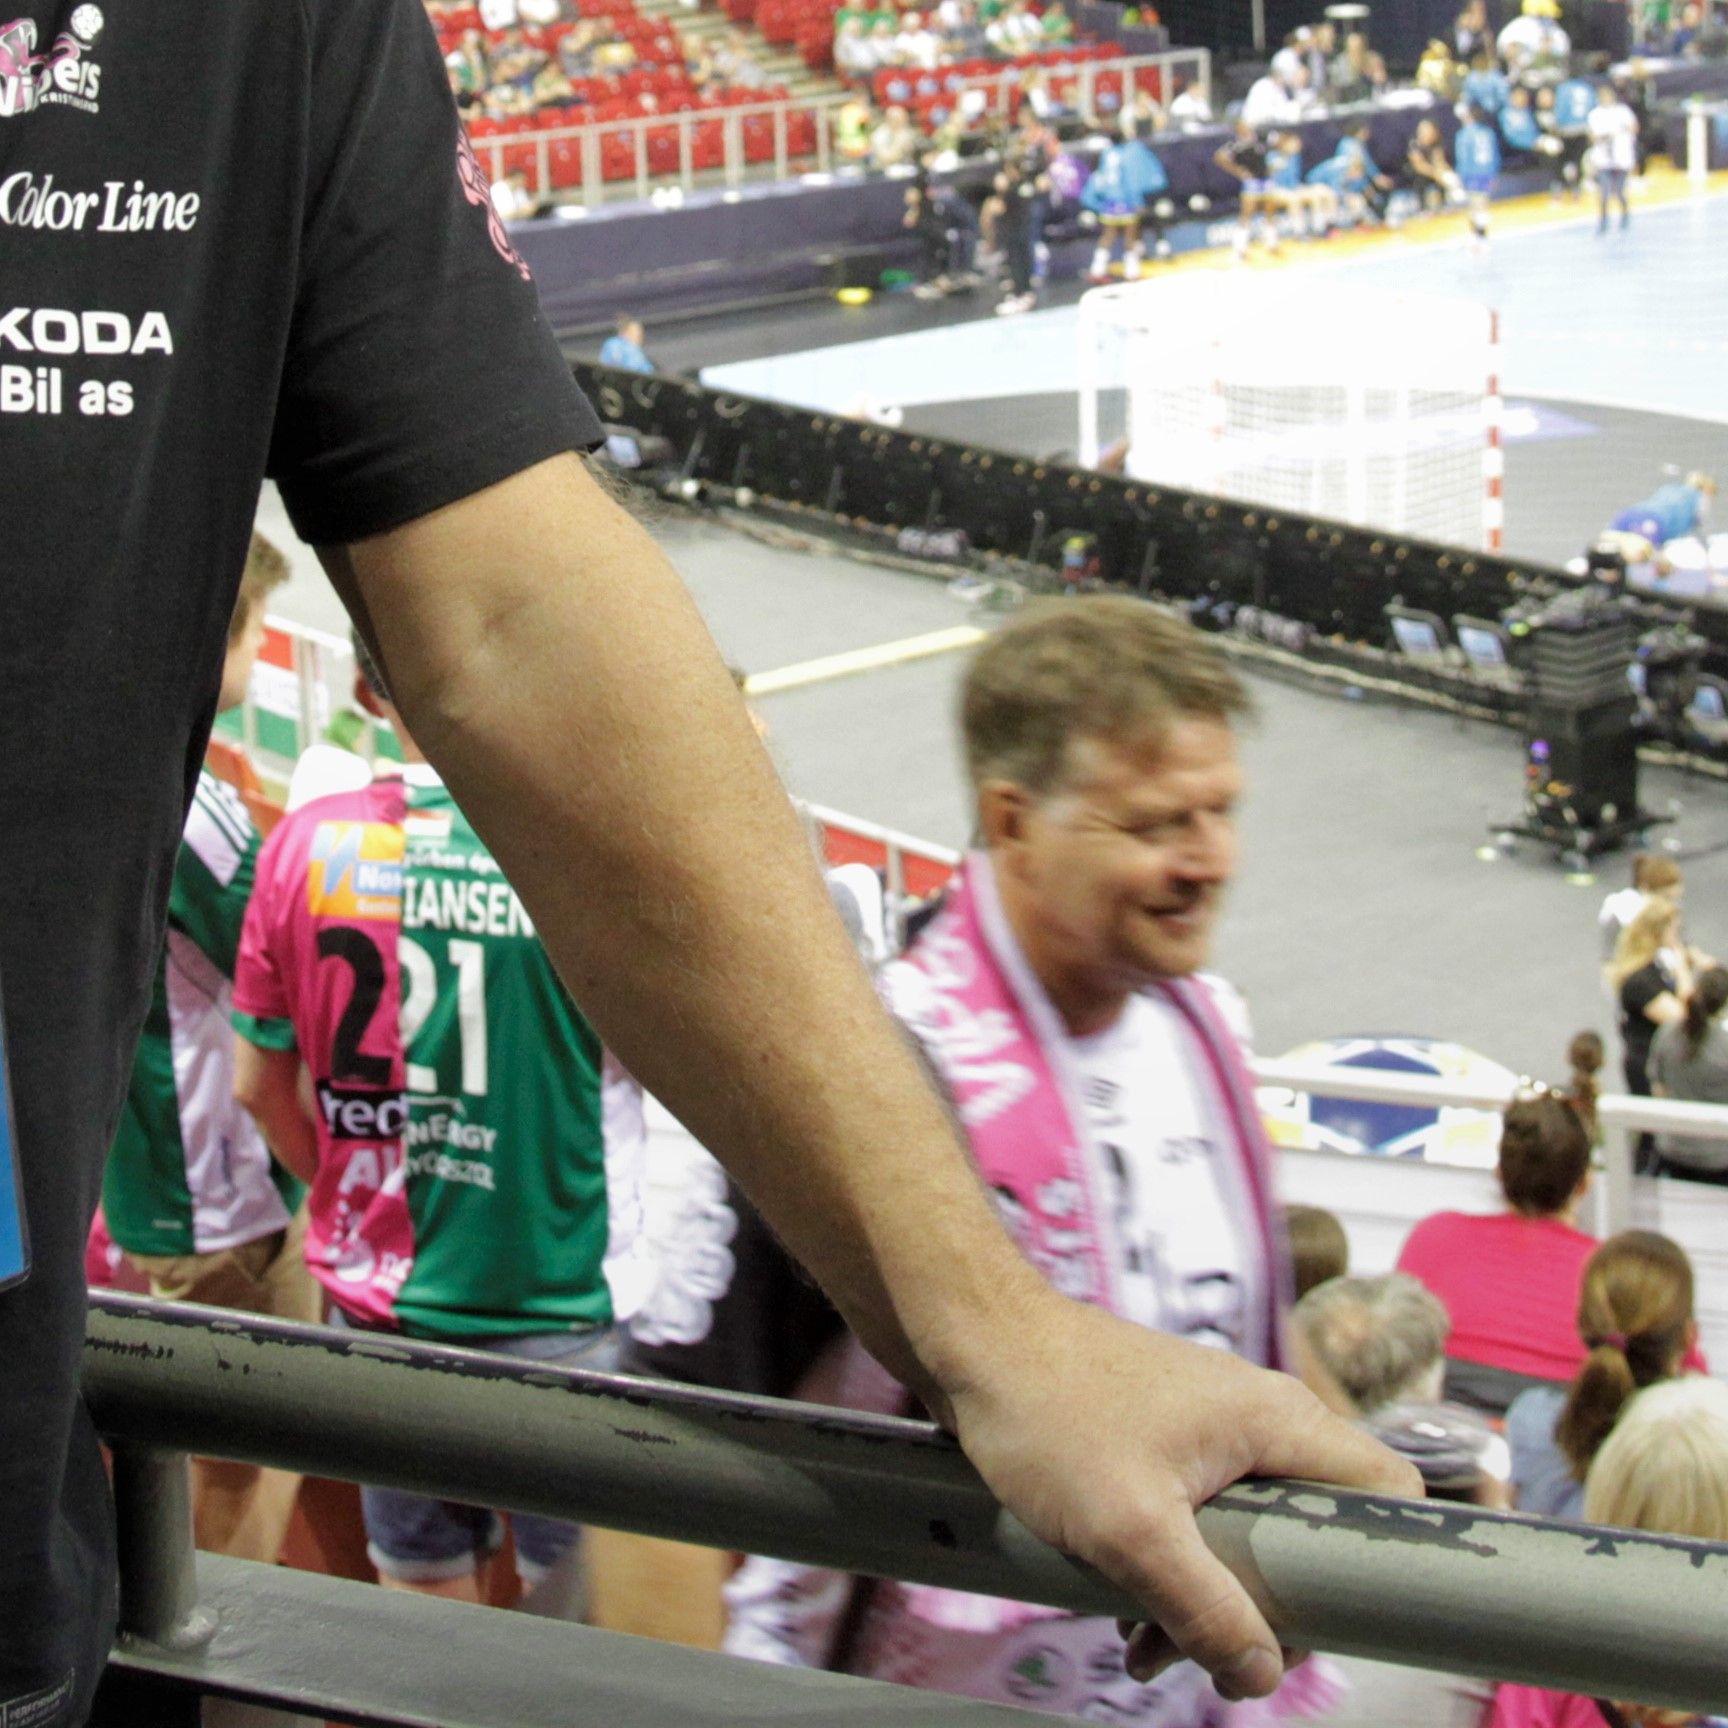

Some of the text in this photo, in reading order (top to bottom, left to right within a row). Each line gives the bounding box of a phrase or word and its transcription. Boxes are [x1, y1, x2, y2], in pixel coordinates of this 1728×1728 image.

[97, 180, 200, 232] Line
[79, 379, 135, 416] as
[317, 926, 392, 1085] 2
